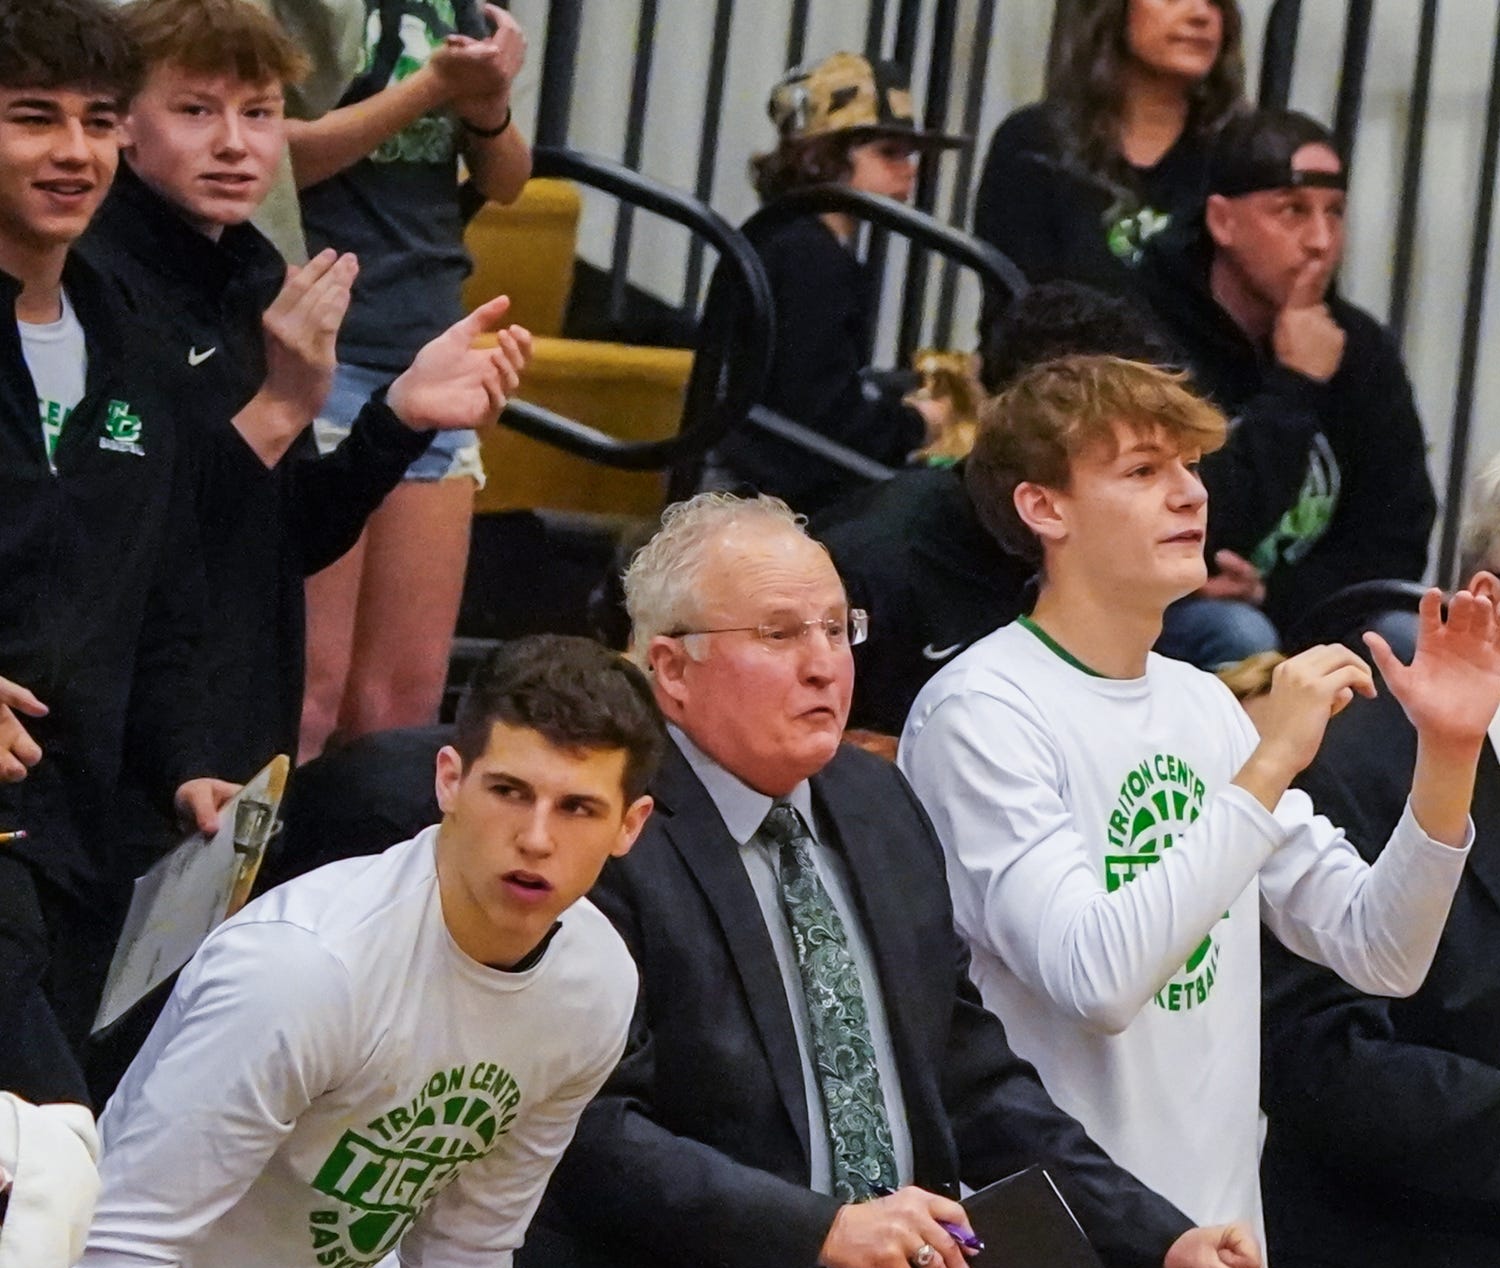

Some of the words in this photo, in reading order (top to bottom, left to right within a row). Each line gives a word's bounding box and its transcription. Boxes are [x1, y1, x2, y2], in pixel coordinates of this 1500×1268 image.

[1108, 759, 1155, 848] TRITON
[1155, 753, 1206, 807] CENTR
[367, 1064, 466, 1141] TRITON
